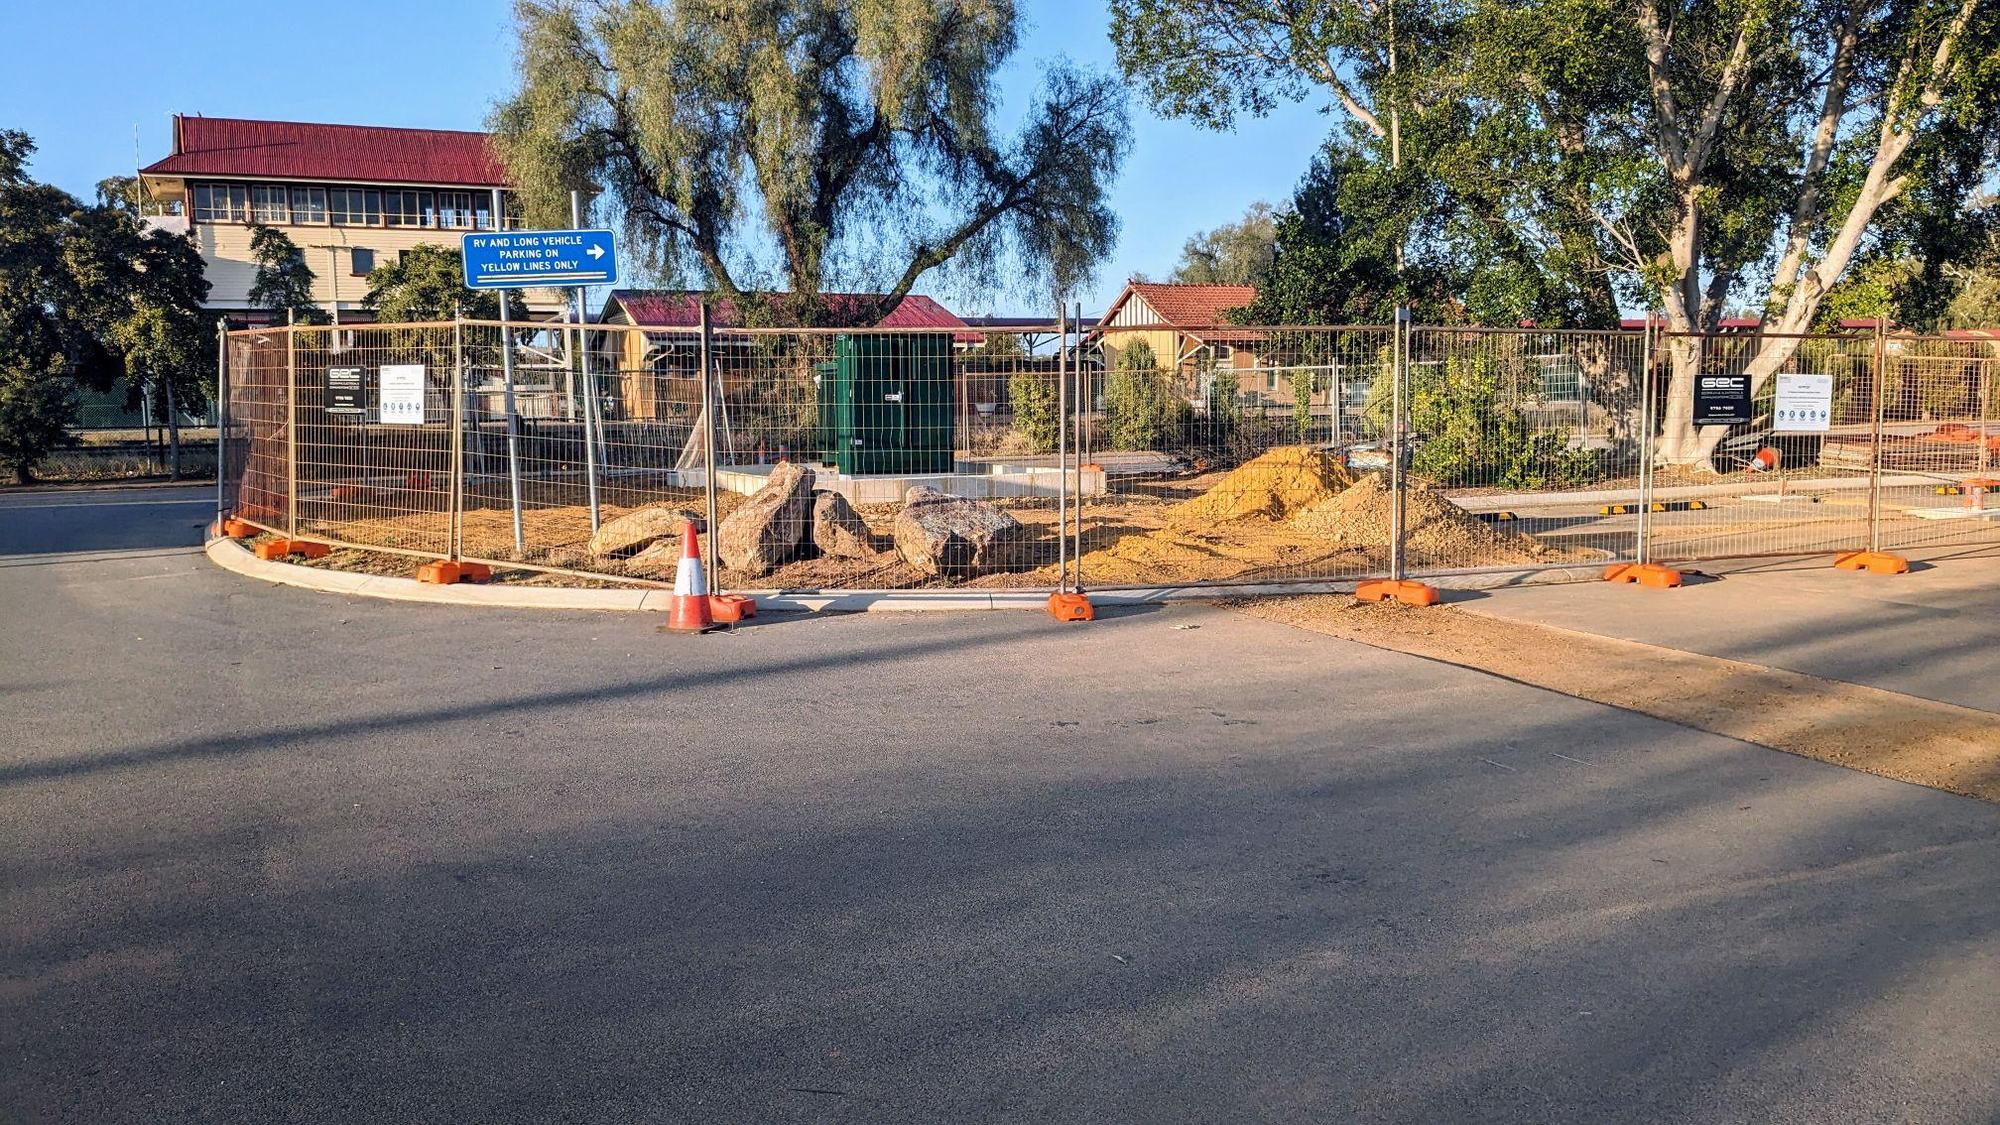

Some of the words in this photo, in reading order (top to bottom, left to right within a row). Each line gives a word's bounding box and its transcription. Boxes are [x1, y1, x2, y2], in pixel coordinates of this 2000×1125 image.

[474, 239, 486, 248] RV
[489, 238, 510, 247] AND
[513, 237, 539, 247] LONG
[543, 236, 582, 246] VEHICLE
[500, 249, 542, 259] PARKING
[545, 249, 559, 258] ON
[481, 262, 521, 272] YELLOW
[523, 261, 551, 271] LINES
[554, 260, 579, 270] ONLY
